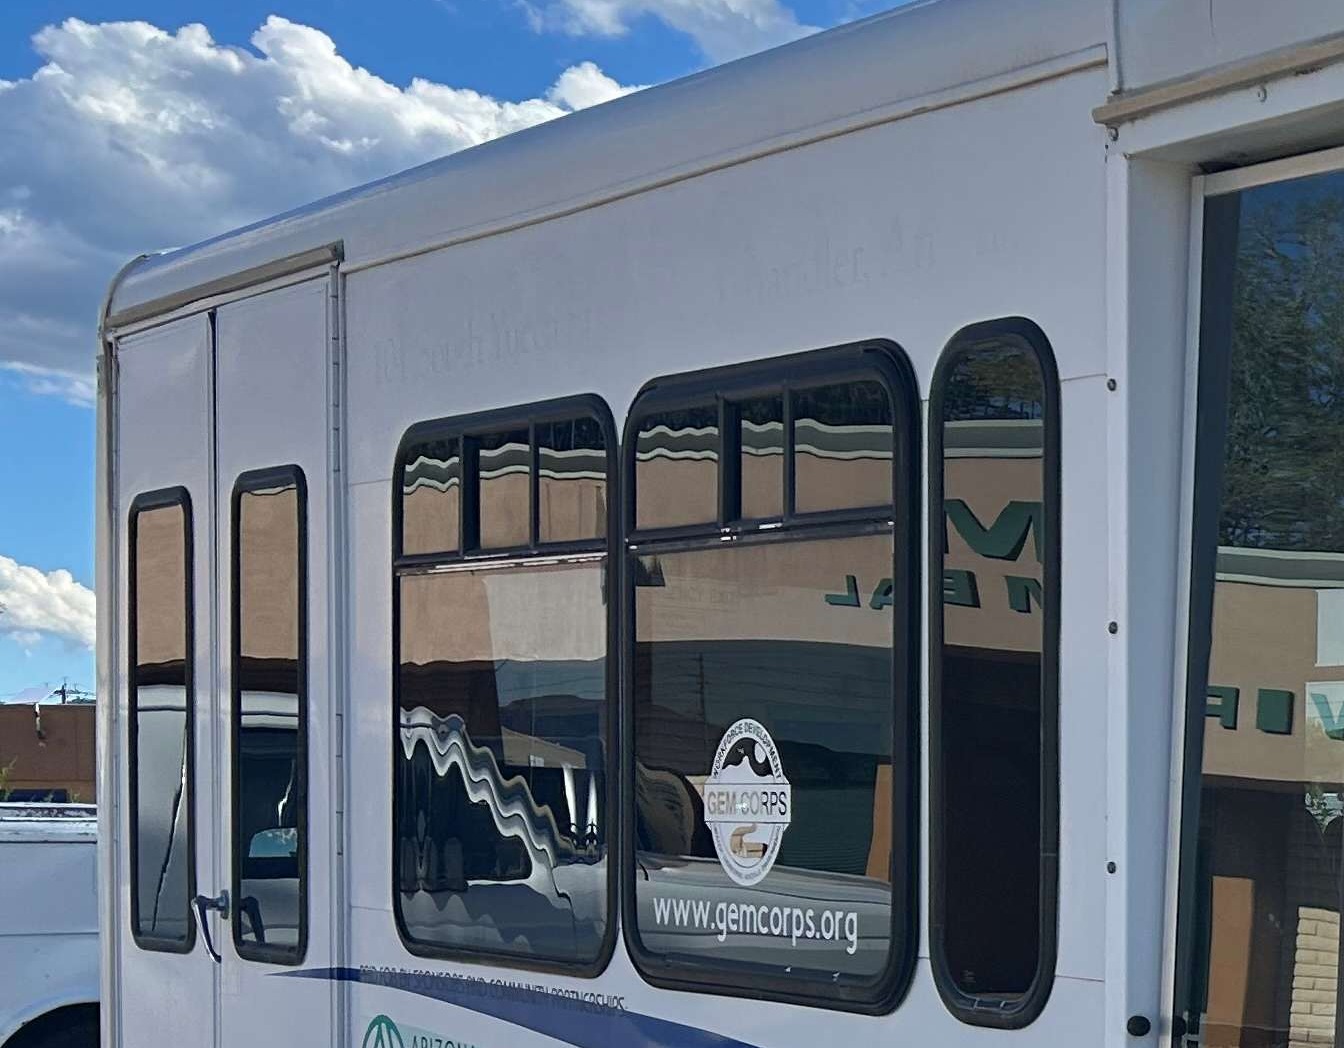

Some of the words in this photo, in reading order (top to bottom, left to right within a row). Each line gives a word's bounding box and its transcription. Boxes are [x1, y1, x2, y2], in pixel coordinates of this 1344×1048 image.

[707, 791, 737, 814] GEM
[740, 791, 787, 815] CORPS
[653, 897, 858, 955] www.gemcorps.org
